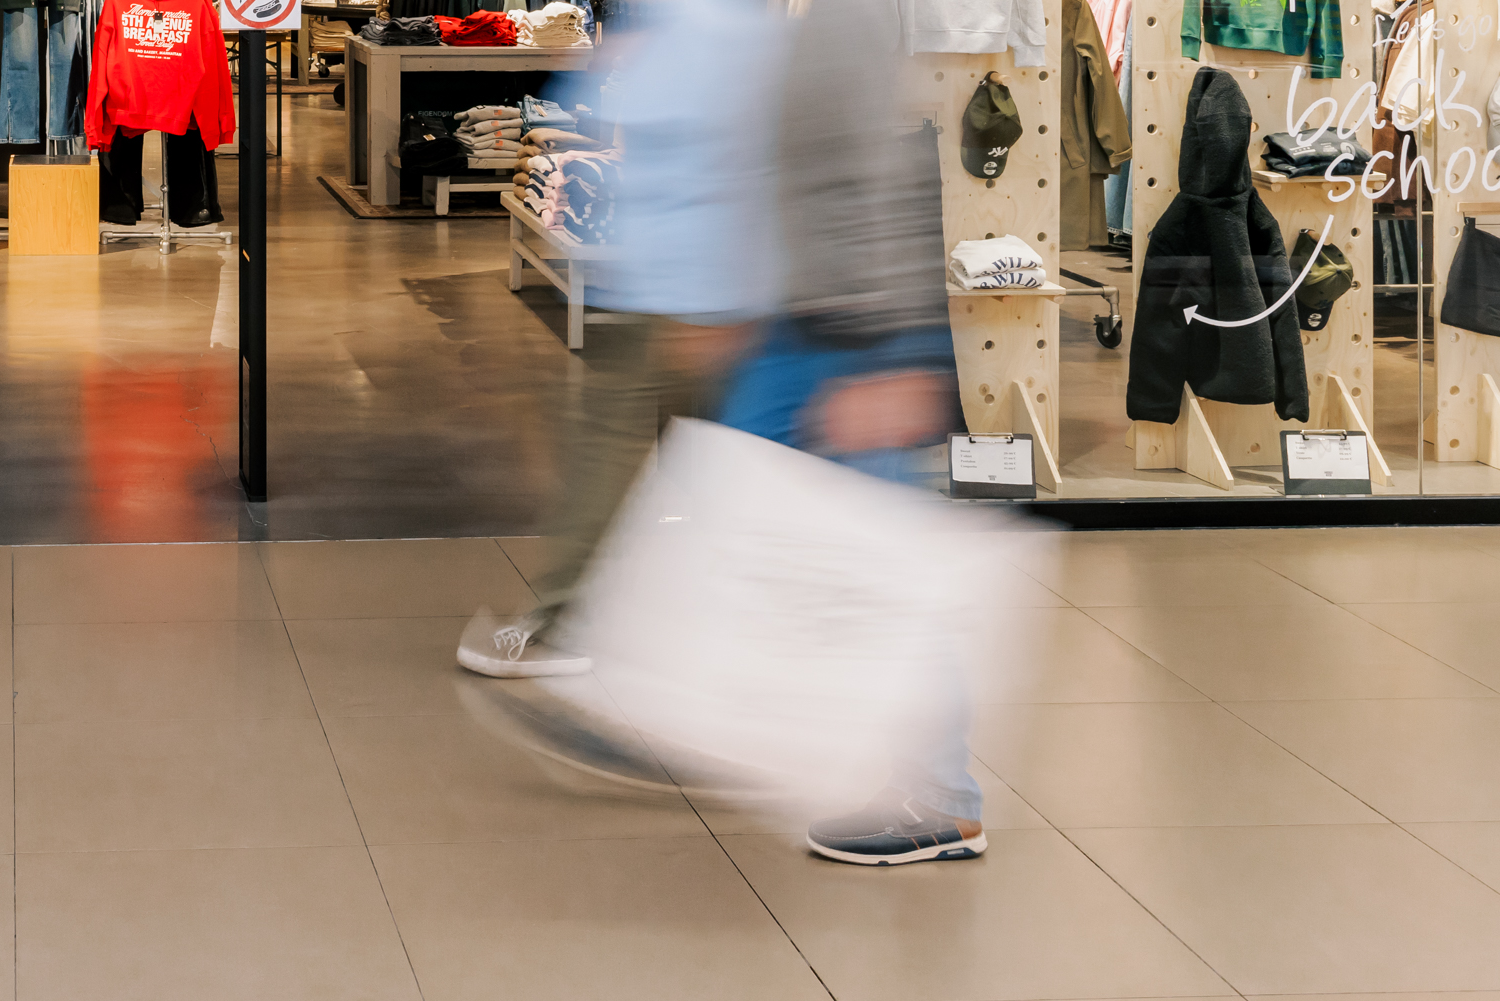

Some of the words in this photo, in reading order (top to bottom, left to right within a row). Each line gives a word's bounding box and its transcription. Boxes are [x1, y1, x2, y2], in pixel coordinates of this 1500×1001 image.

[121, 14, 143, 28] 5TH
[146, 16, 193, 32] AENUE
[123, 27, 190, 44] BREAKFAST
[1457, 14, 1493, 52] go
[1286, 48, 1483, 147] back
[1324, 134, 1500, 203] schoo
